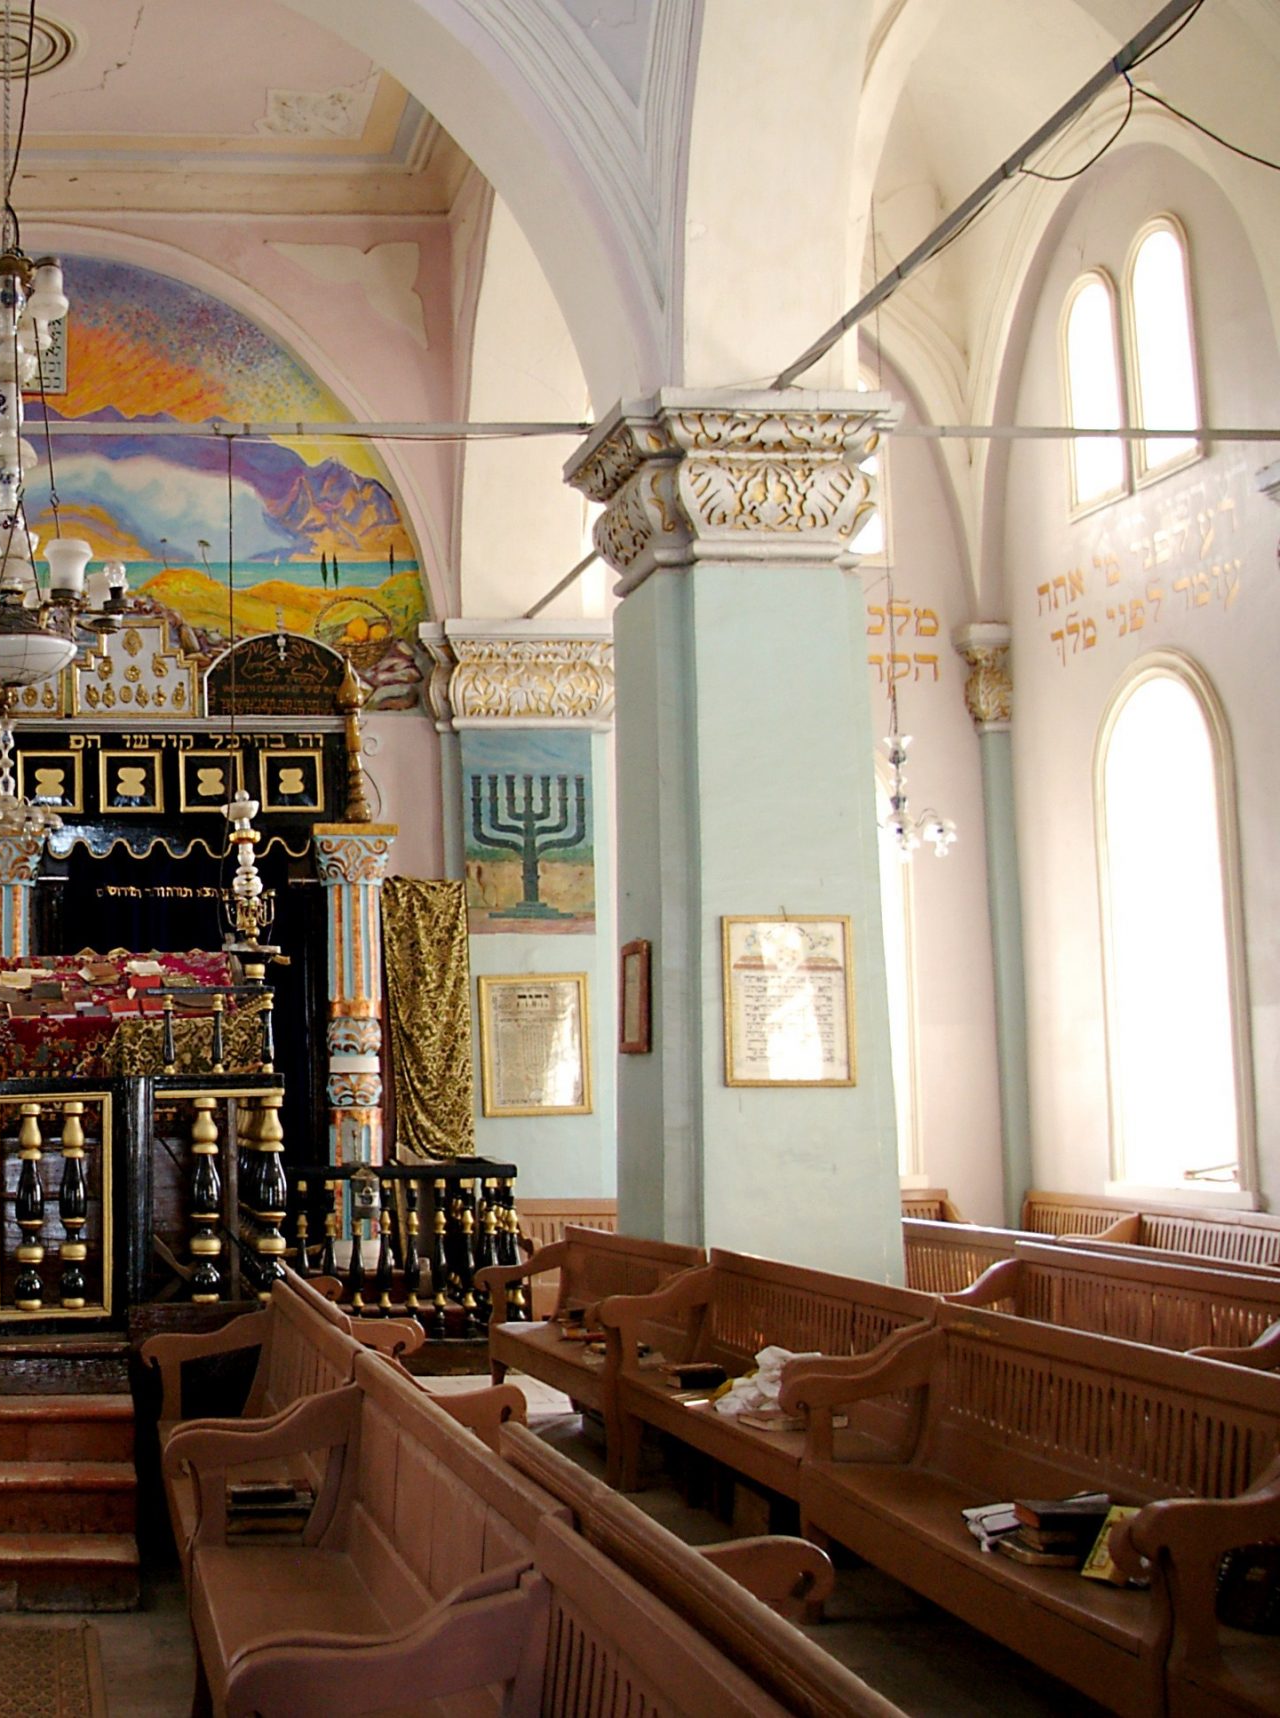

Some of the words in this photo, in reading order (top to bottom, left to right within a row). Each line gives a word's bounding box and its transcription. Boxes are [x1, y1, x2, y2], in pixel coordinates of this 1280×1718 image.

[1037, 567, 1085, 617] אתה
[866, 599, 939, 637] מלכ
[1050, 611, 1097, 668] מלך
[866, 653, 939, 699] הקד
